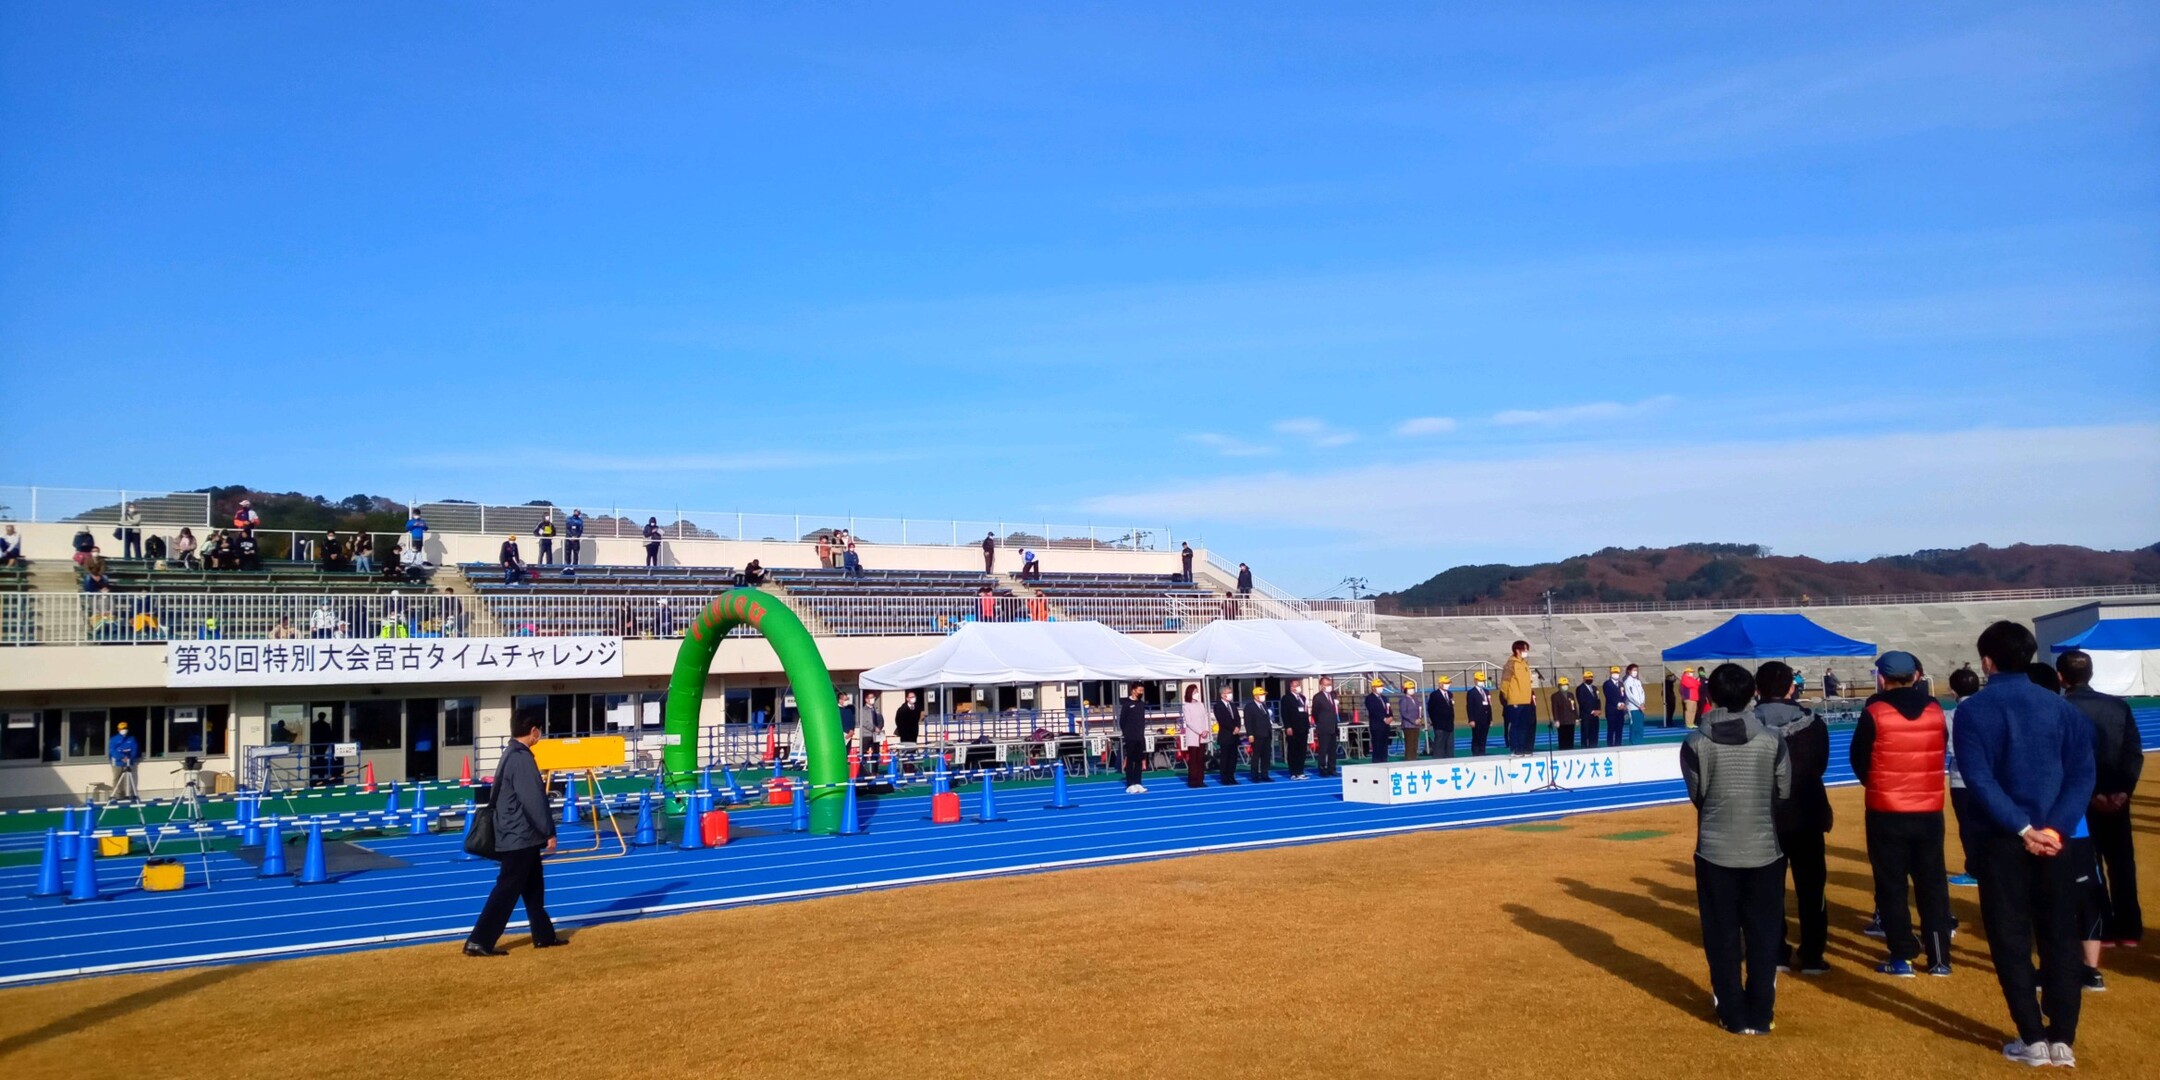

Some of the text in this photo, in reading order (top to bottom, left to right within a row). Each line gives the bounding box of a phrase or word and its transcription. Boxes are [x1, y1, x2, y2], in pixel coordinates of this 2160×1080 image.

[173, 641, 616, 674] 第35回特別大会宮古タイムチャレンジ
[1391, 757, 1613, 796] 宮古サーモン・ハーフマラソン大会
